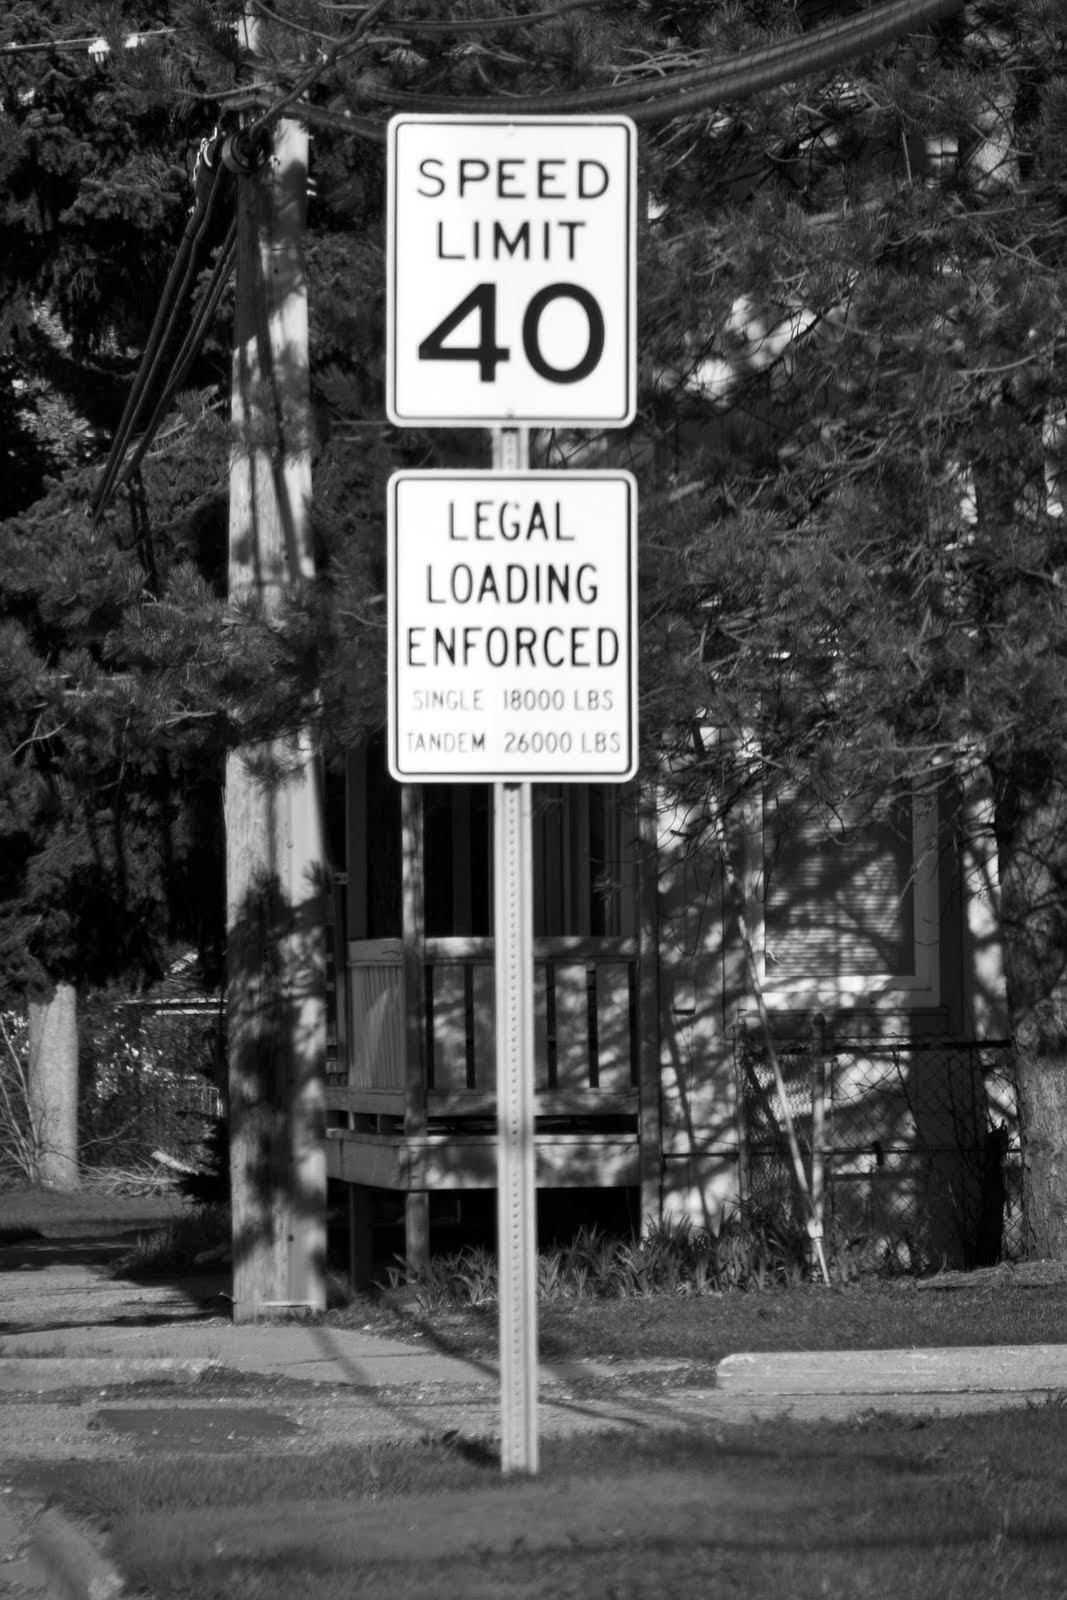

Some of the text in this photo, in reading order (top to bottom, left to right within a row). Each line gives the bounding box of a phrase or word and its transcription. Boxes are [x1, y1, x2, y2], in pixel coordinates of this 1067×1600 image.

[418, 158, 610, 200] SPEED
[437, 220, 586, 261] LIMIT
[418, 281, 605, 385] 40
[449, 501, 574, 541] LEGAL
[427, 563, 598, 605] LOADING
[408, 626, 619, 668] ENFORCED
[412, 688, 613, 712] SINGLE 18000 LBS
[407, 731, 621, 754] TANDEM 26000 LBS
